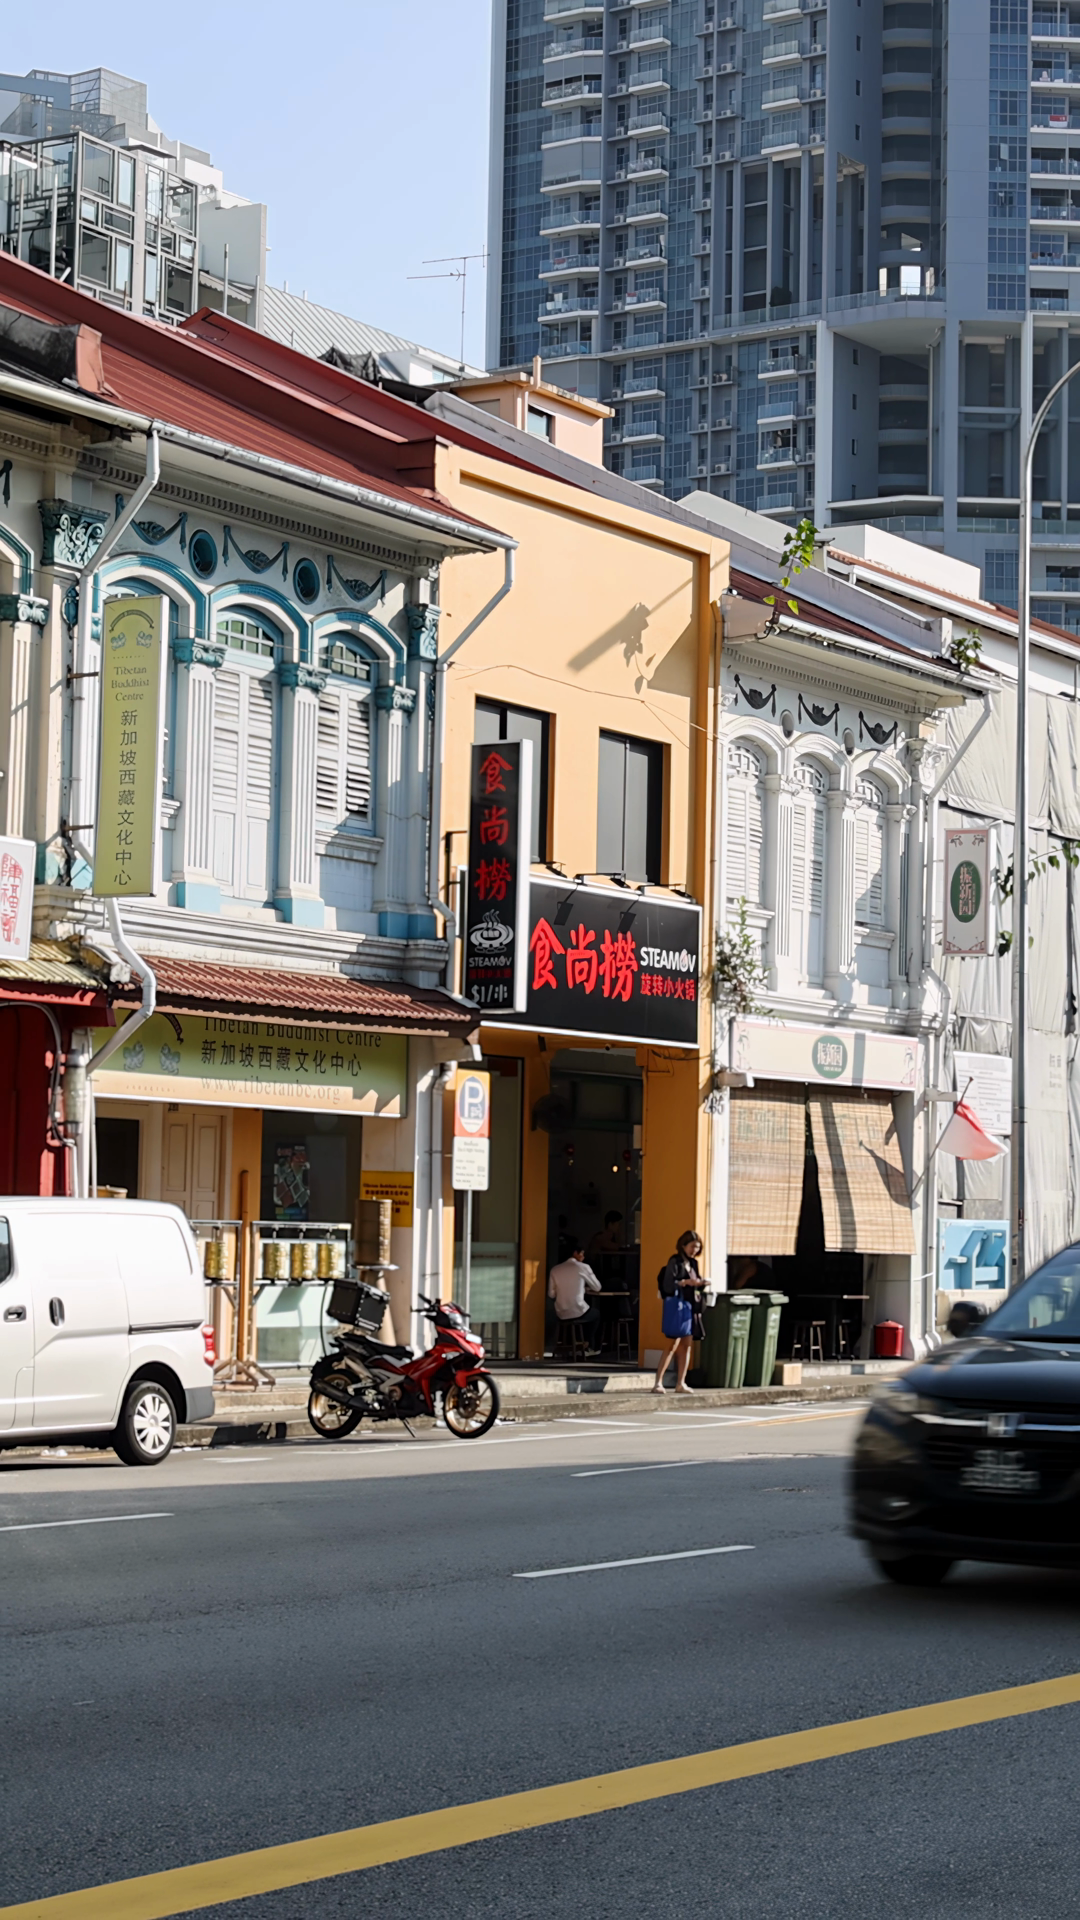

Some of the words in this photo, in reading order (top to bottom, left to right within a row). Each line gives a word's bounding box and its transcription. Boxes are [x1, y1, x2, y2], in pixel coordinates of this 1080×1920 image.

[113, 666, 147, 676] Tibetan
[111, 678, 150, 689] Buddhist
[115, 692, 144, 702] Centre
[113, 709, 138, 886] 新加坡西藏文化中心
[336, 1029, 382, 1048] Centre
[201, 1039, 362, 1077] 新加坡西藏文化中心
